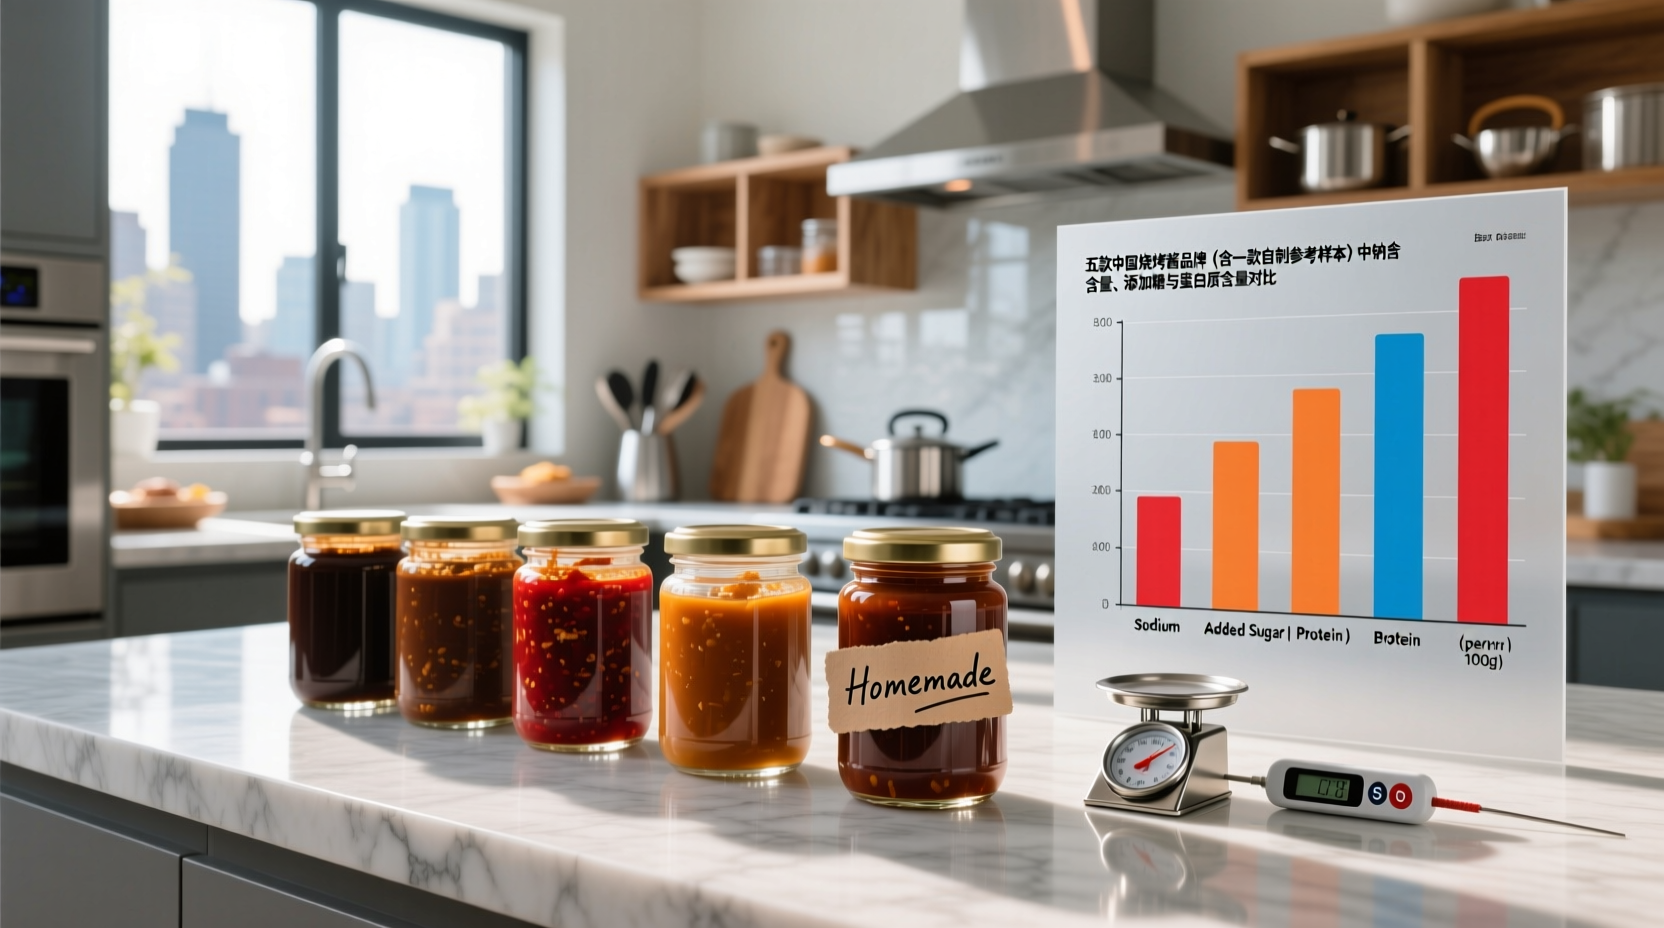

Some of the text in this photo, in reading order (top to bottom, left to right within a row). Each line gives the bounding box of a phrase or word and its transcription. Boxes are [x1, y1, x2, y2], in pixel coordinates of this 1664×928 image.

[1134, 617, 1180, 633] Sodium
[1203, 621, 1246, 637] Added
[1465, 653, 1504, 671] 100g)
[845, 651, 996, 706] Homemade
[1372, 786, 1382, 801] S
